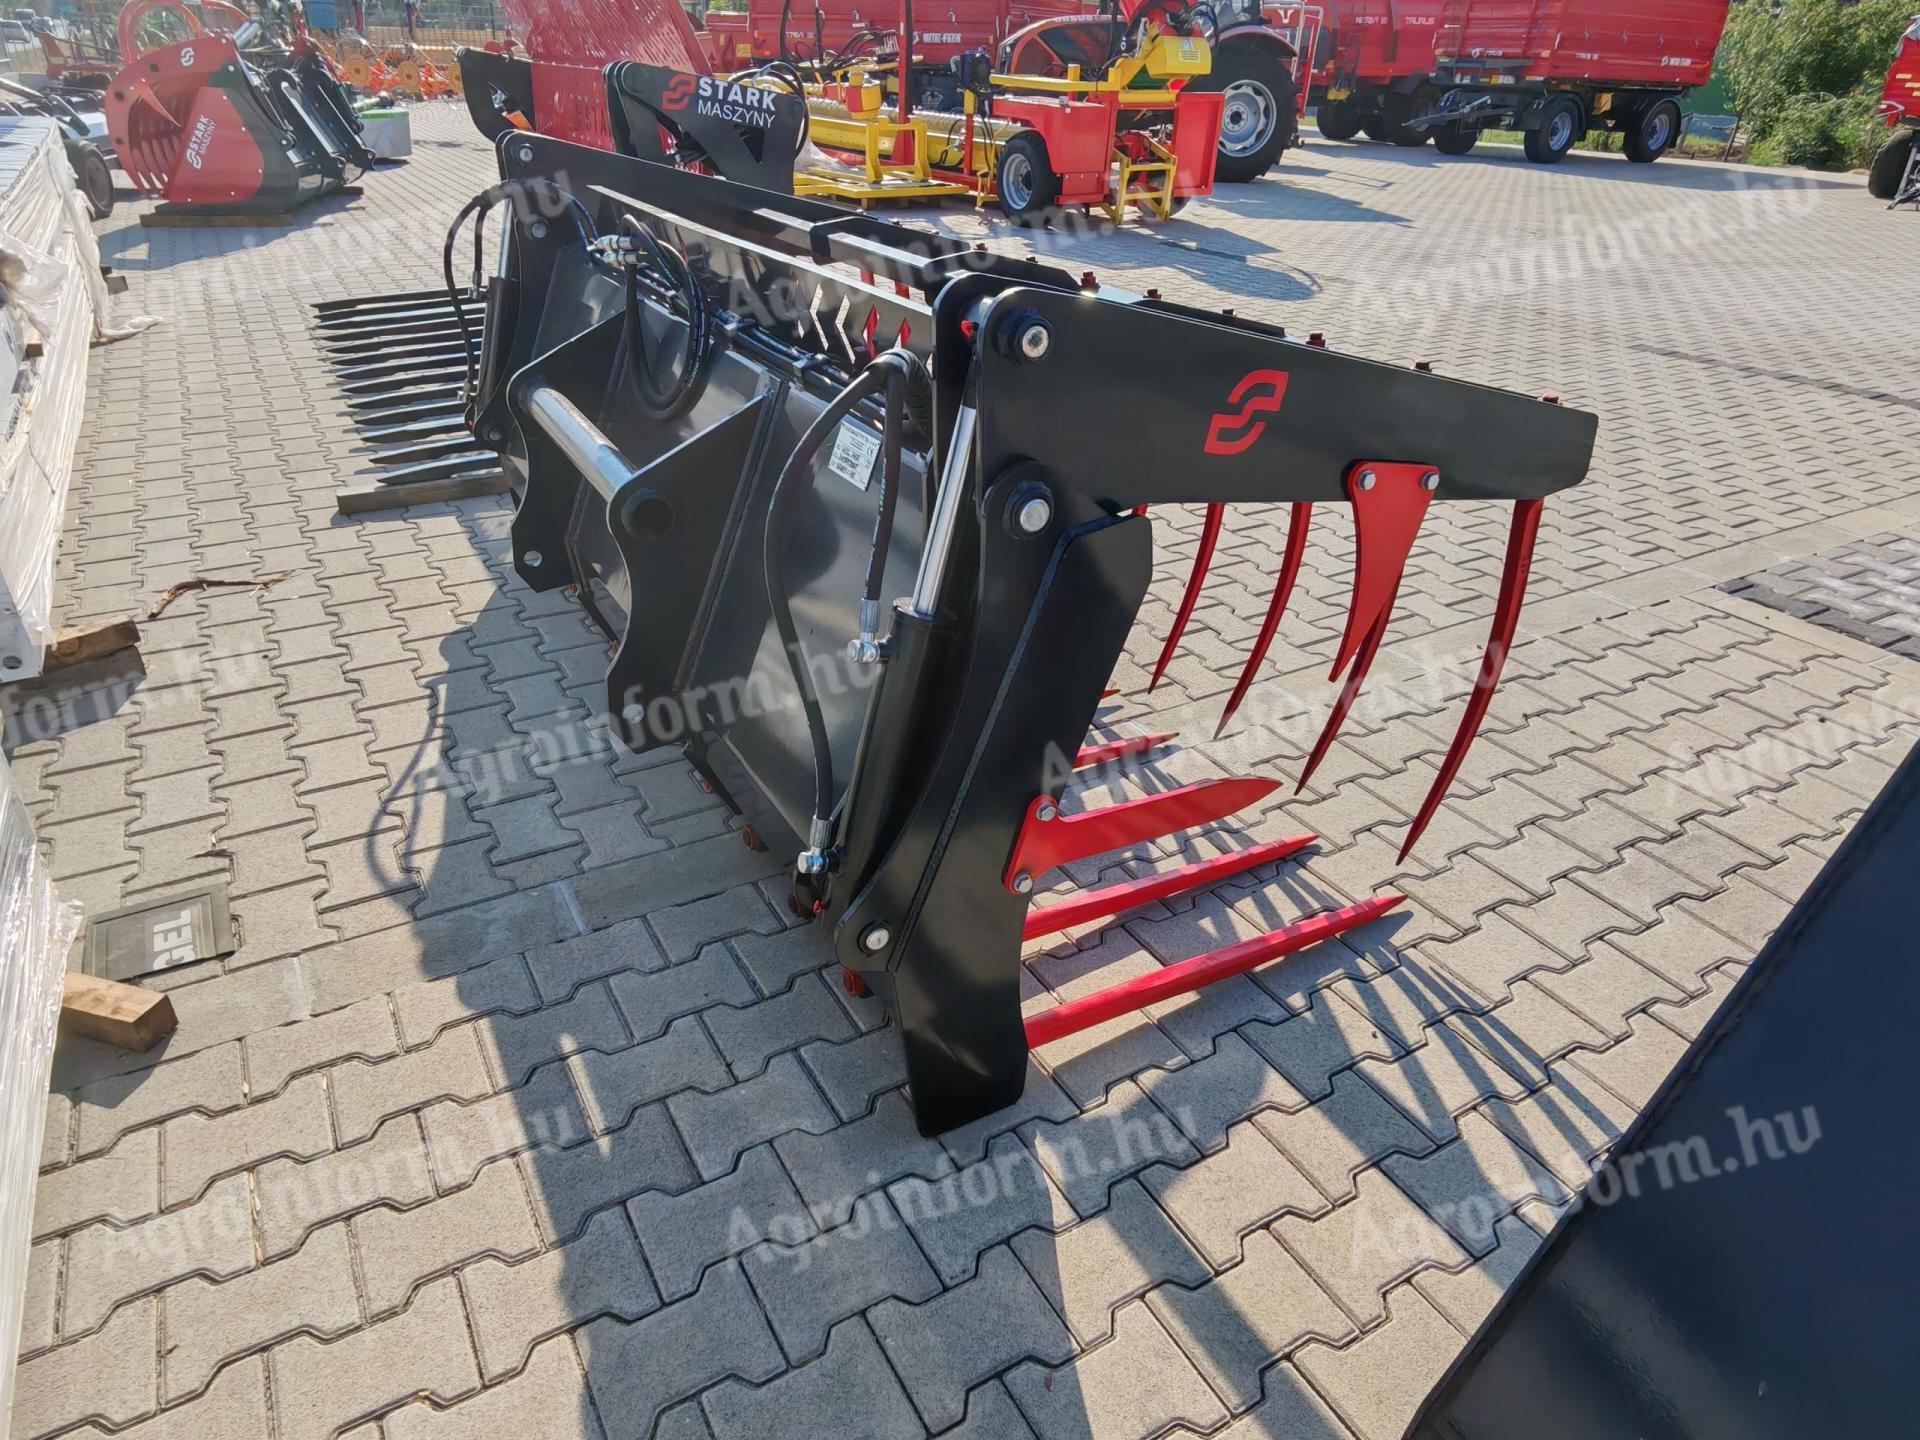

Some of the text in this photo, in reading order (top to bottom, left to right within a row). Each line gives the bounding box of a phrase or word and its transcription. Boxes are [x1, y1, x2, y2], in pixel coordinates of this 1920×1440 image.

[699, 77, 777, 111] STARK
[698, 100, 775, 128] MASZYNY
[190, 115, 209, 151] STARK
